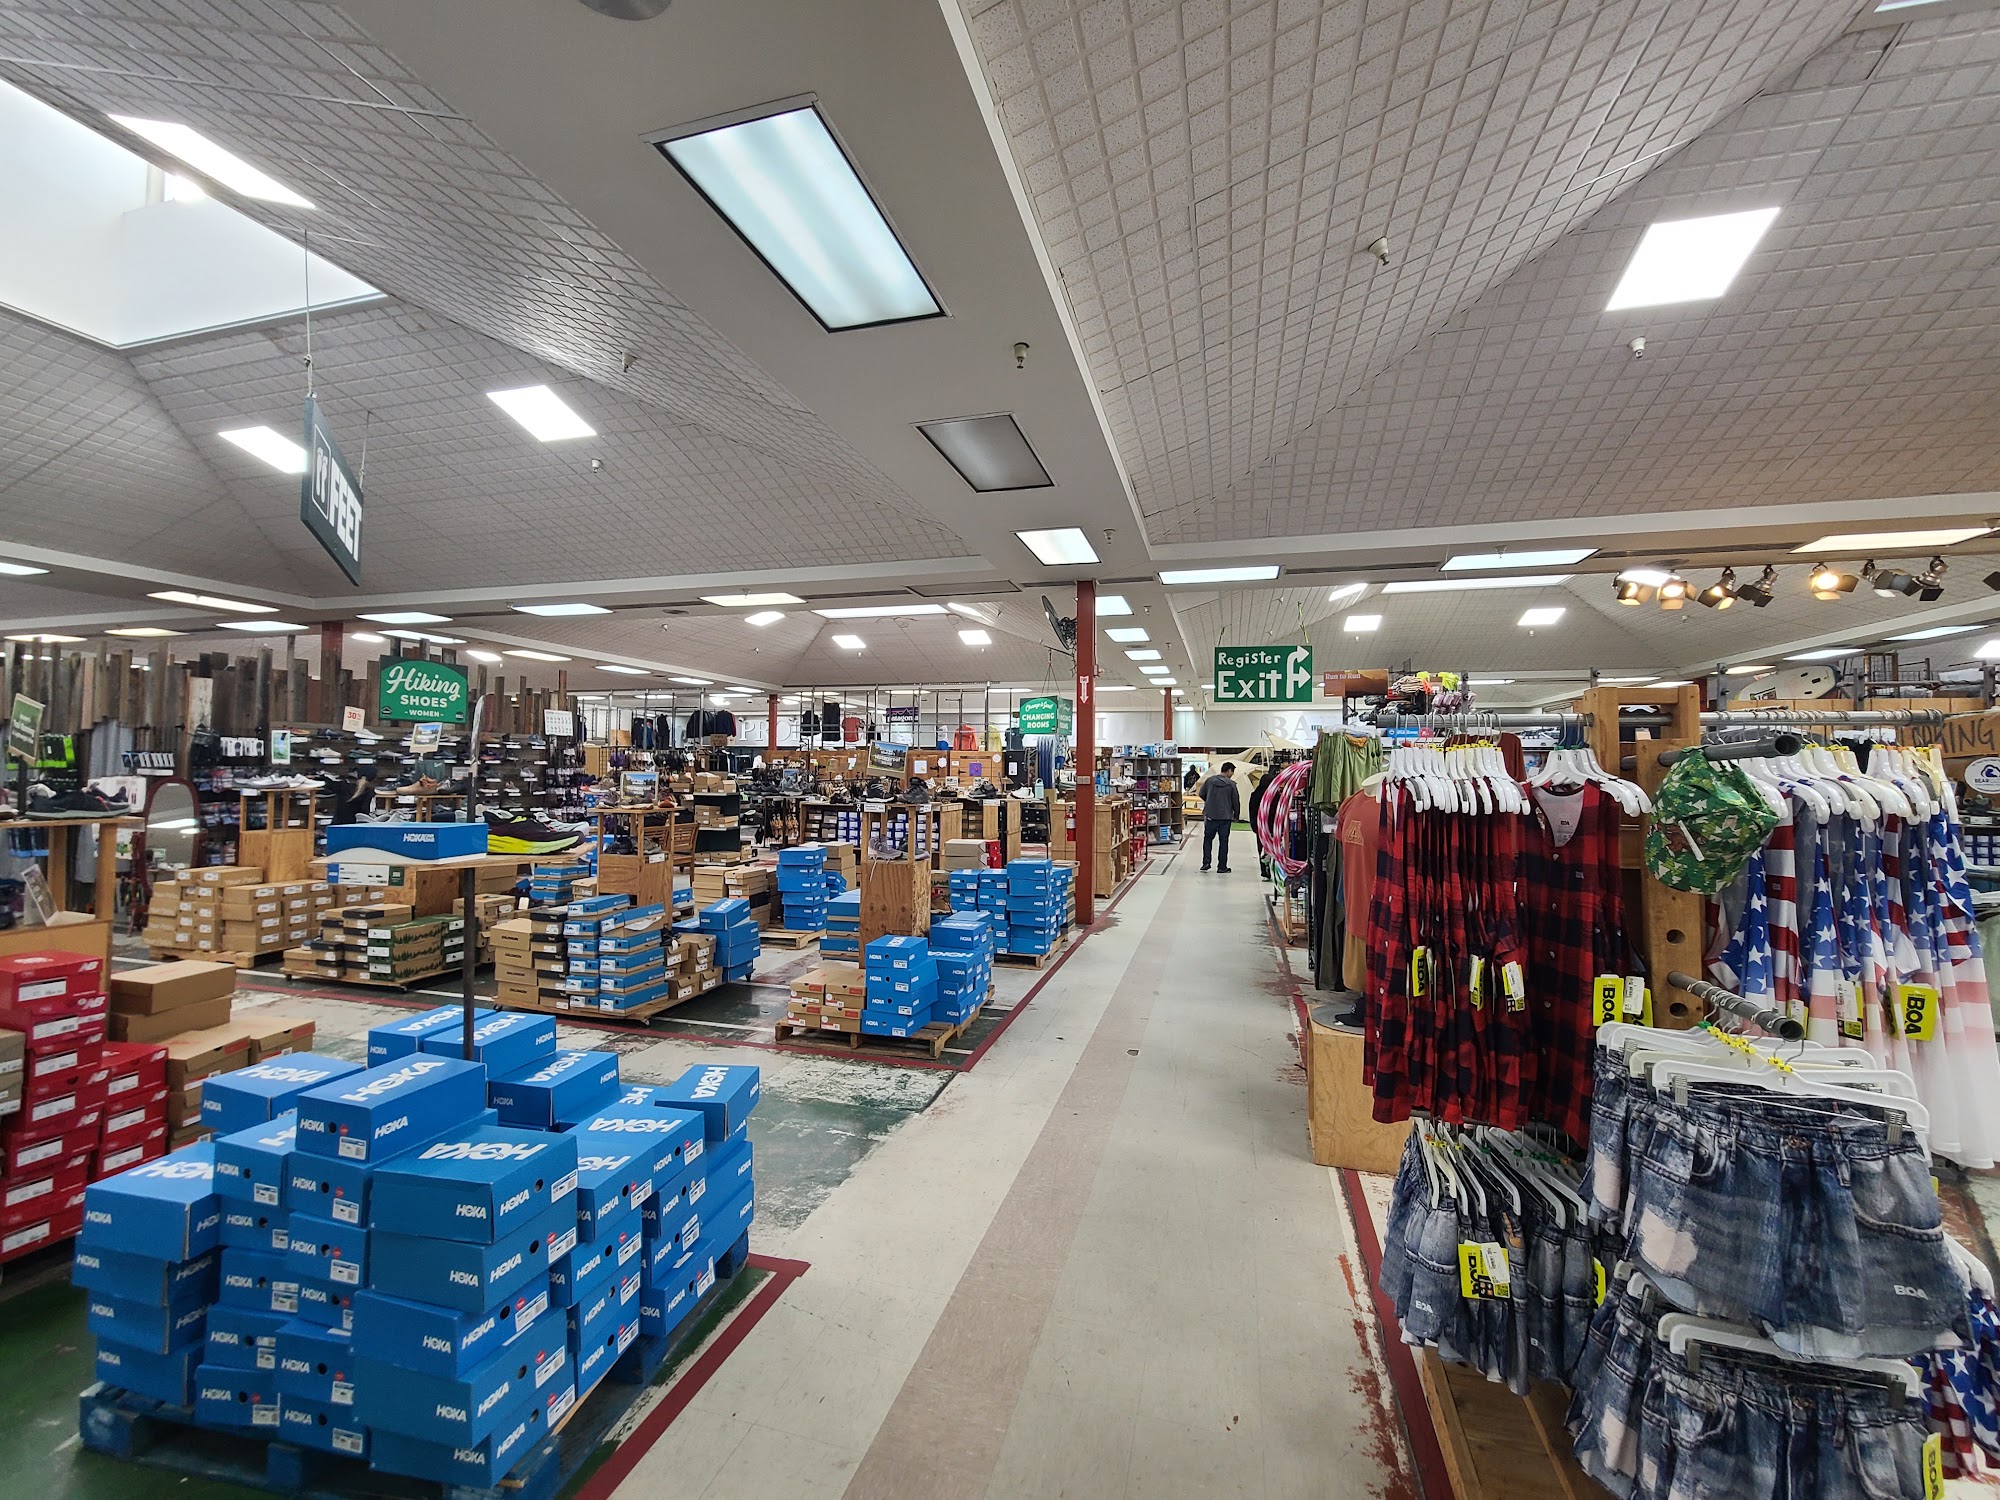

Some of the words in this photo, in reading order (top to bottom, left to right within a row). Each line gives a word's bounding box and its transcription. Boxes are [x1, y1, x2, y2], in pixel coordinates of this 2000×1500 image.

[329, 457, 362, 562] FEET
[1218, 652, 1281, 668] Register
[386, 665, 461, 701] Hiking
[1217, 669, 1282, 699] Exit
[400, 694, 448, 708] SHOES
[1022, 712, 1055, 721] CHANGING
[535, 1031, 554, 1046] HOKA
[370, 1046, 387, 1055] HOKA
[340, 1061, 446, 1102] HOKA
[600, 1069, 617, 1085] HOKA
[691, 1066, 729, 1099] HOKA
[203, 1100, 221, 1112] HOKA
[493, 1096, 513, 1106] HOKA
[300, 1119, 324, 1133] HOKA
[374, 1116, 408, 1139] HOKA
[588, 1118, 683, 1133] HOKA
[418, 1142, 548, 1160] HOKA
[128, 1160, 213, 1179] HOK
[216, 1162, 239, 1177] HOKA
[653, 1152, 672, 1174] HOKA
[737, 1158, 751, 1176] HOKA
[292, 1177, 316, 1191] HOKA
[499, 1189, 530, 1216] HOKA
[598, 1195, 619, 1220] HOKA
[662, 1194, 679, 1217] HOKA
[740, 1199, 752, 1218] HOKA
[86, 1211, 112, 1224] HOKA
[456, 1203, 486, 1219] HOKA
[226, 1214, 253, 1227] HOKA
[290, 1240, 316, 1255] HOKA
[654, 1241, 672, 1265] HOKA
[76, 1254, 100, 1269] HOKA
[490, 1253, 522, 1283] HOKA
[576, 1254, 601, 1281] HOKA
[225, 1275, 253, 1288] HOKA
[450, 1270, 478, 1287] HOKA
[301, 1287, 327, 1302] HOKA
[1893, 1284, 1928, 1300] BOA
[667, 1288, 685, 1313] HOKA
[91, 1304, 115, 1318] HOKA
[584, 1298, 605, 1326] HOKA
[640, 1305, 660, 1318] OKA
[210, 1331, 238, 1344] HOKA
[461, 1317, 495, 1350] HOKA
[423, 1335, 451, 1354] HOKA
[97, 1350, 121, 1365] HOKA
[281, 1358, 310, 1373] HOKA
[581, 1345, 604, 1375] HOKA
[201, 1388, 231, 1401] HOKA
[477, 1381, 509, 1417] HOKA
[284, 1409, 312, 1425] HOKA
[436, 1404, 467, 1422] HOKA
[496, 1422, 526, 1459] HOKA
[453, 1448, 485, 1465] HOKA
